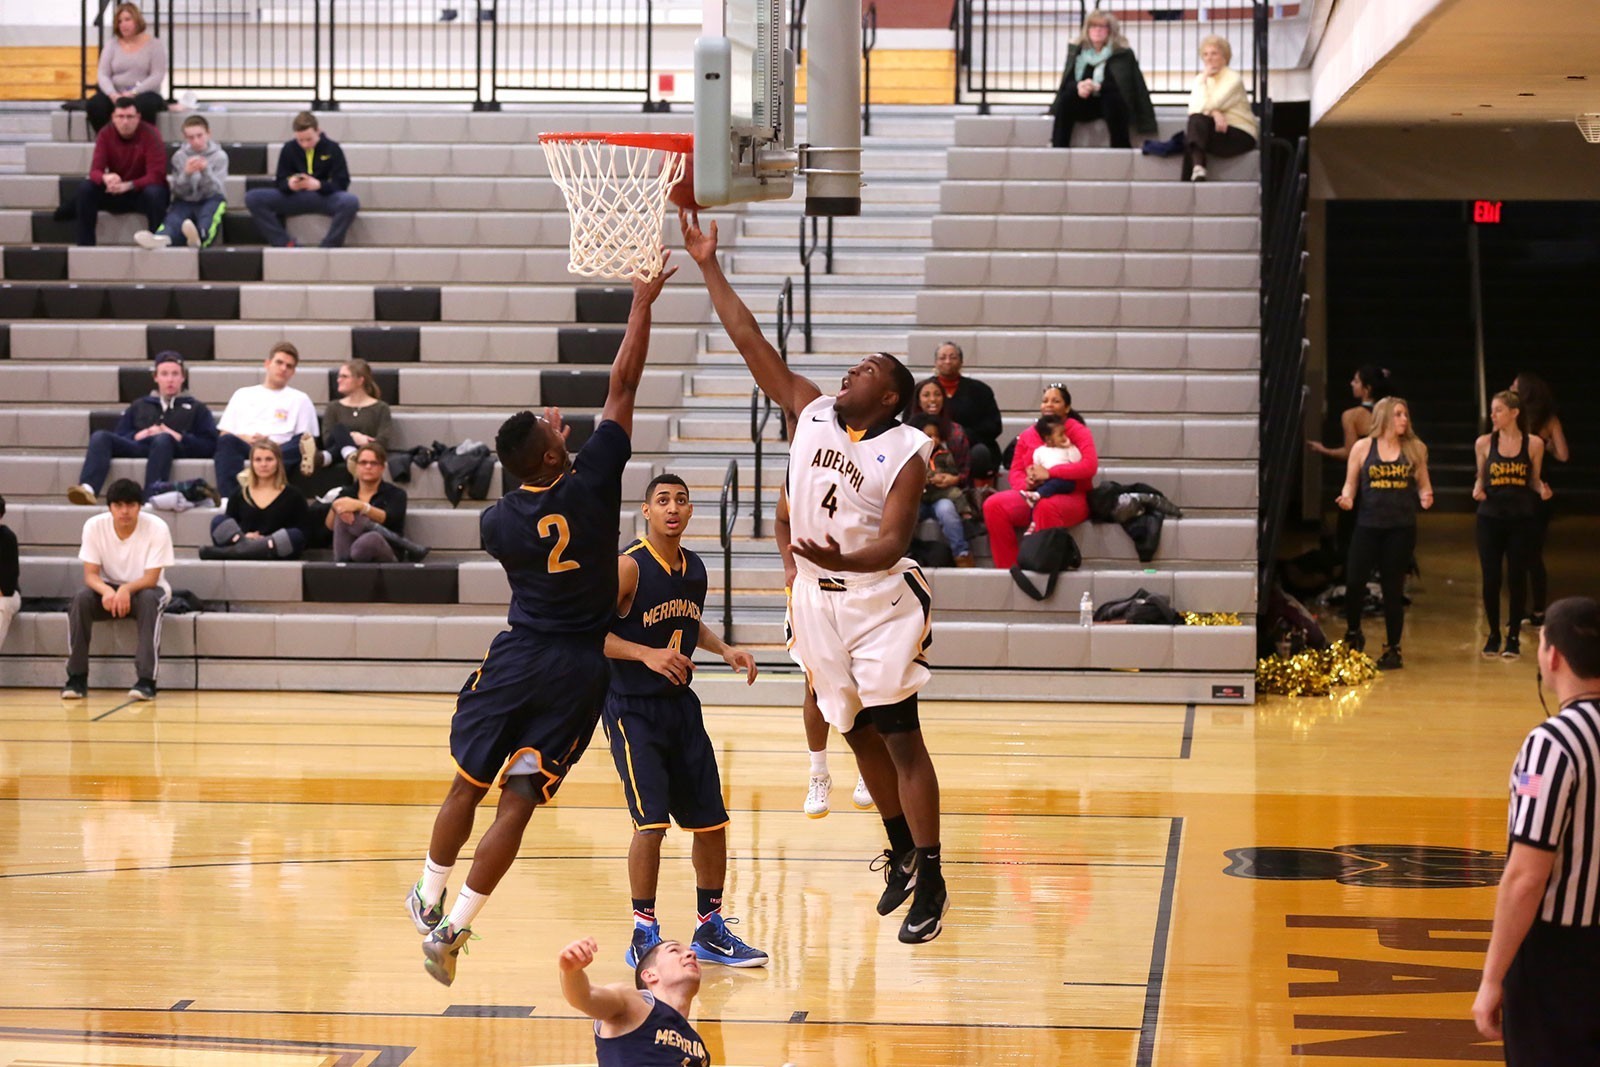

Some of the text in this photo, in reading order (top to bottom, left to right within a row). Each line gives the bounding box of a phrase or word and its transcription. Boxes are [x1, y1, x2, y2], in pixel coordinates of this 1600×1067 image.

[1474, 200, 1502, 223] EXIT
[811, 448, 865, 493] ADELPHI
[821, 483, 838, 519] 4
[537, 513, 581, 574] 2
